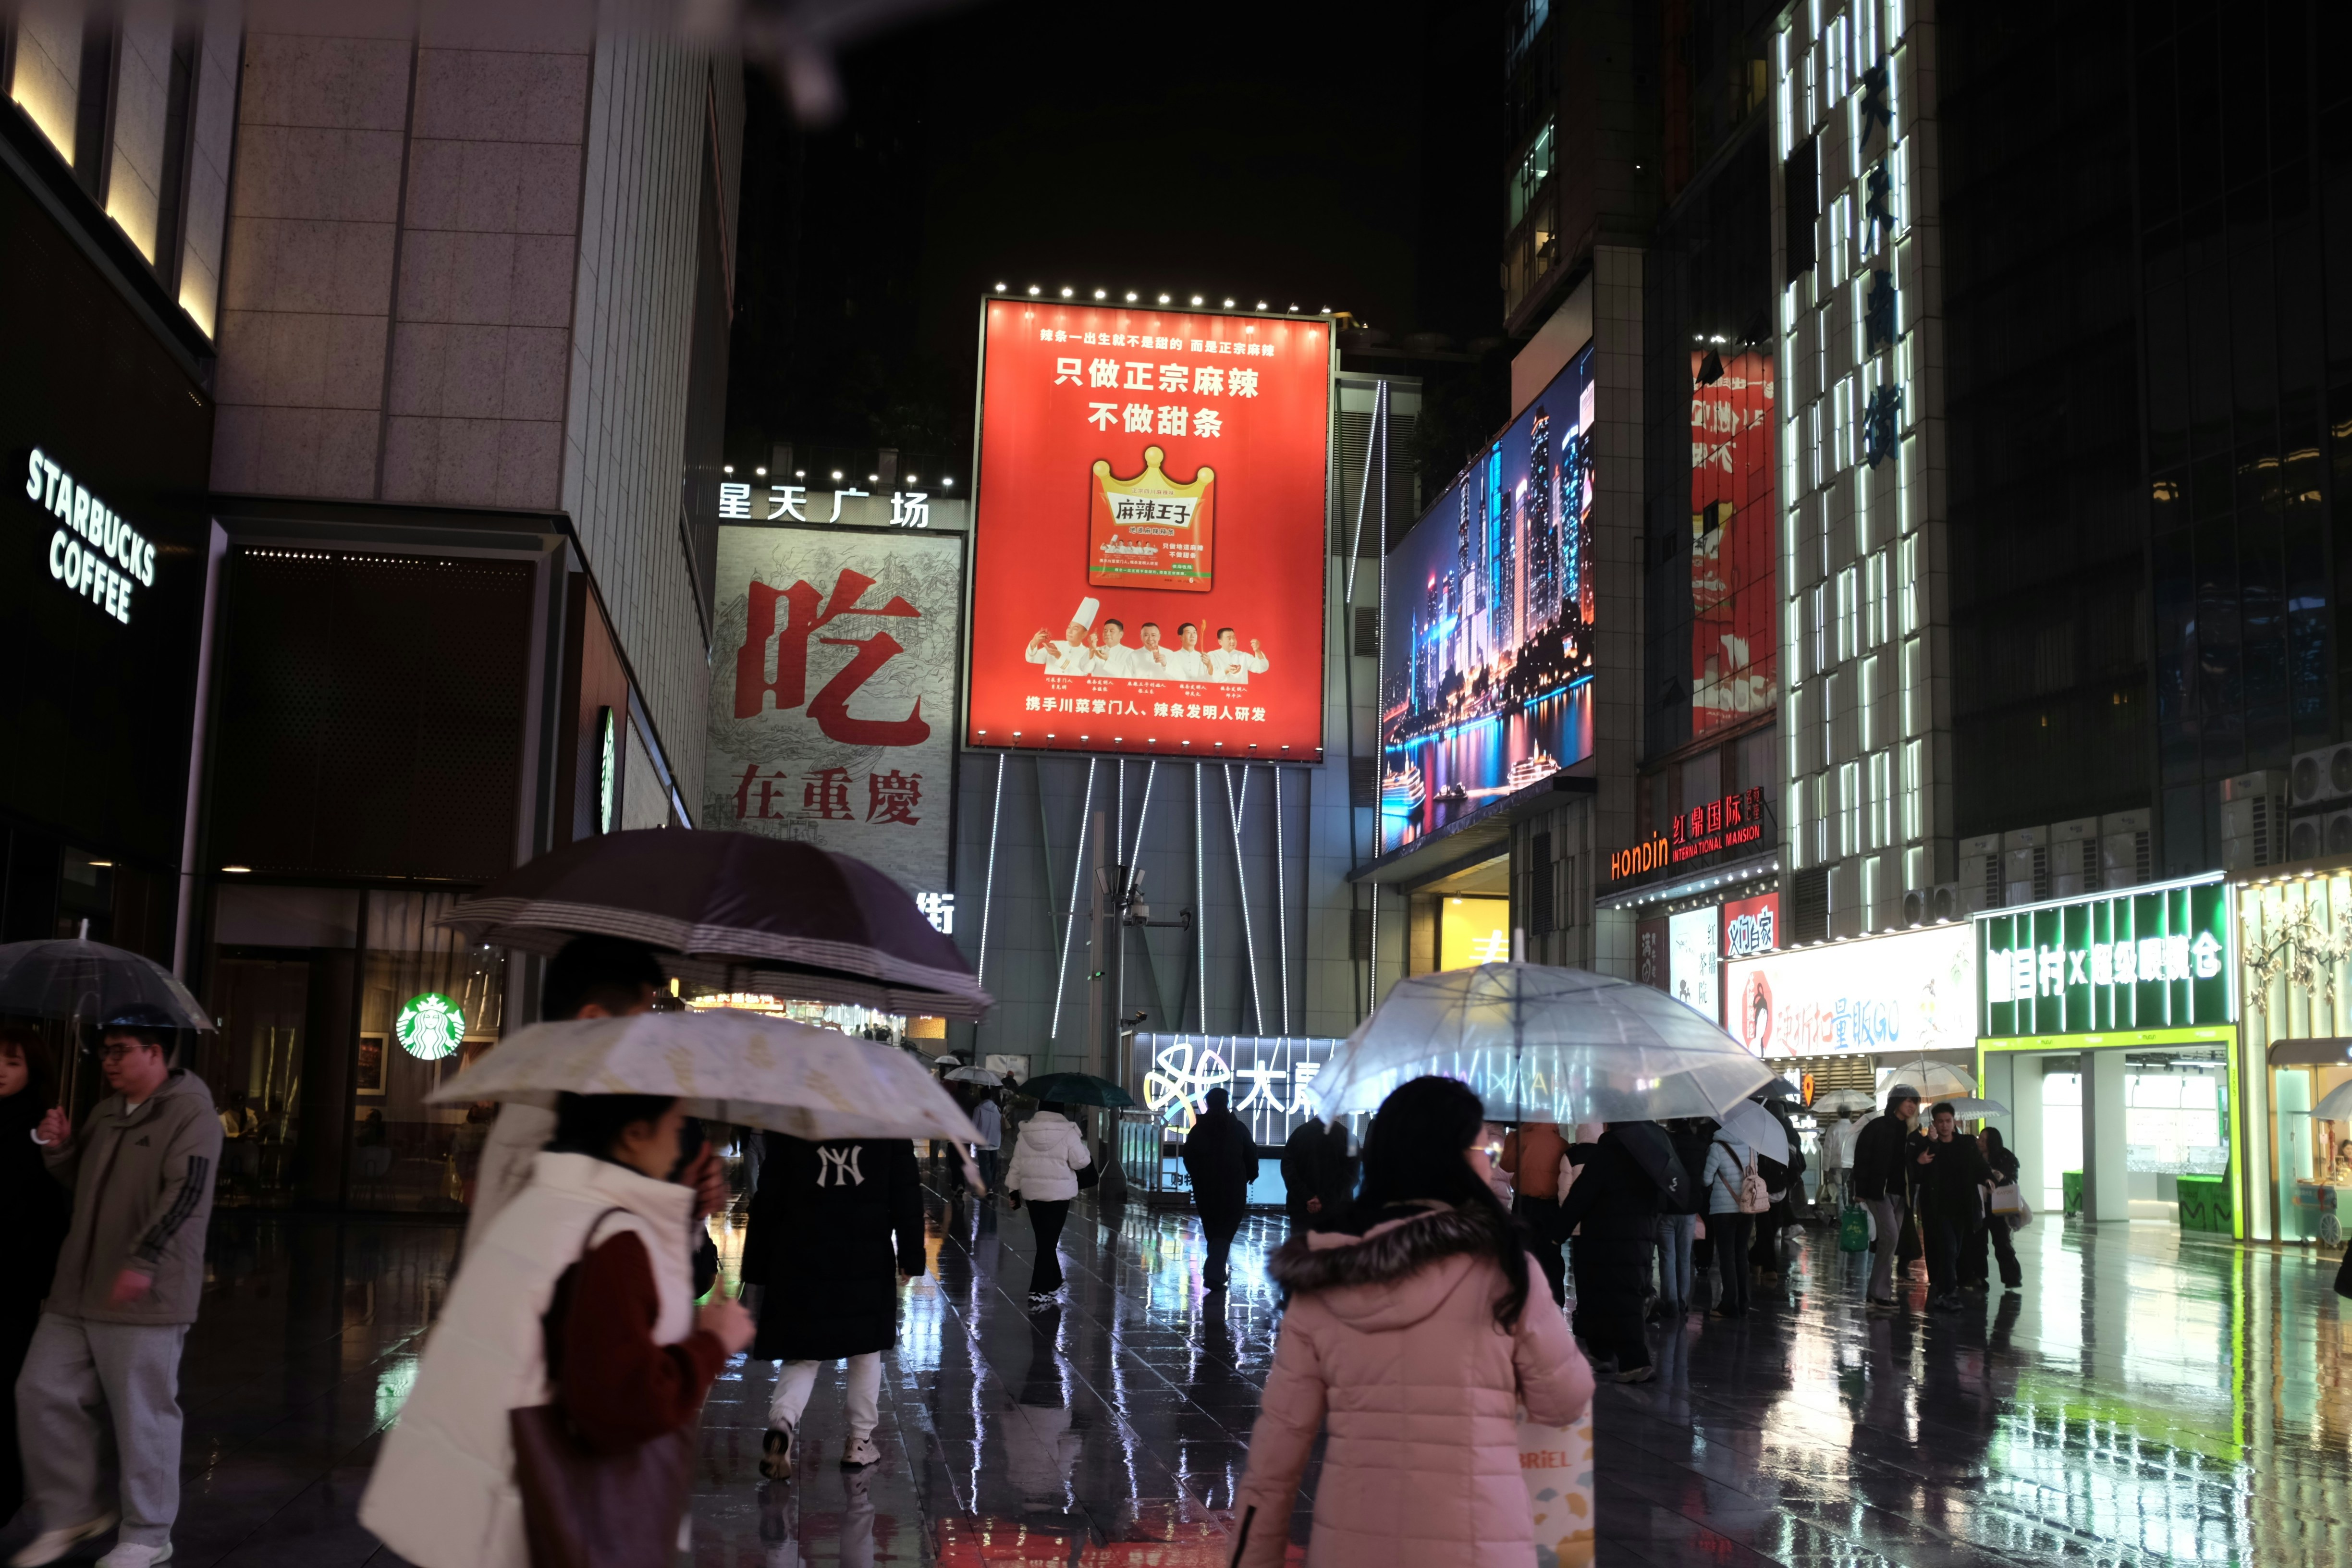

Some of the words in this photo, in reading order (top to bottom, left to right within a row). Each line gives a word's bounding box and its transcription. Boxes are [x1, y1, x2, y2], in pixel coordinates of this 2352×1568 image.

[1040, 329, 1183, 351] 辣条一出生就不是甜的
[1190, 339, 1275, 357] 而是正宗麻辣
[1054, 358, 1259, 398] 只做正宗麻辣
[1088, 402, 1223, 438] 不做甜条
[26, 449, 156, 587] STARBUCKS
[719, 482, 929, 528] 星天广场
[1116, 499, 1190, 524] 麻辣王子
[49, 530, 132, 625] COFFEE
[1026, 695, 1266, 722] 携手川菜掌门人、辣条发明人研发
[732, 763, 923, 826] 在重慶
[1673, 794, 1742, 845] 红鼎国际
[1673, 837, 1723, 863] INTERNATIONAL
[1726, 825, 1760, 846] MANSION
[1707, 923, 1717, 974] 红鼎
[1699, 952, 1707, 1005] 茶院
